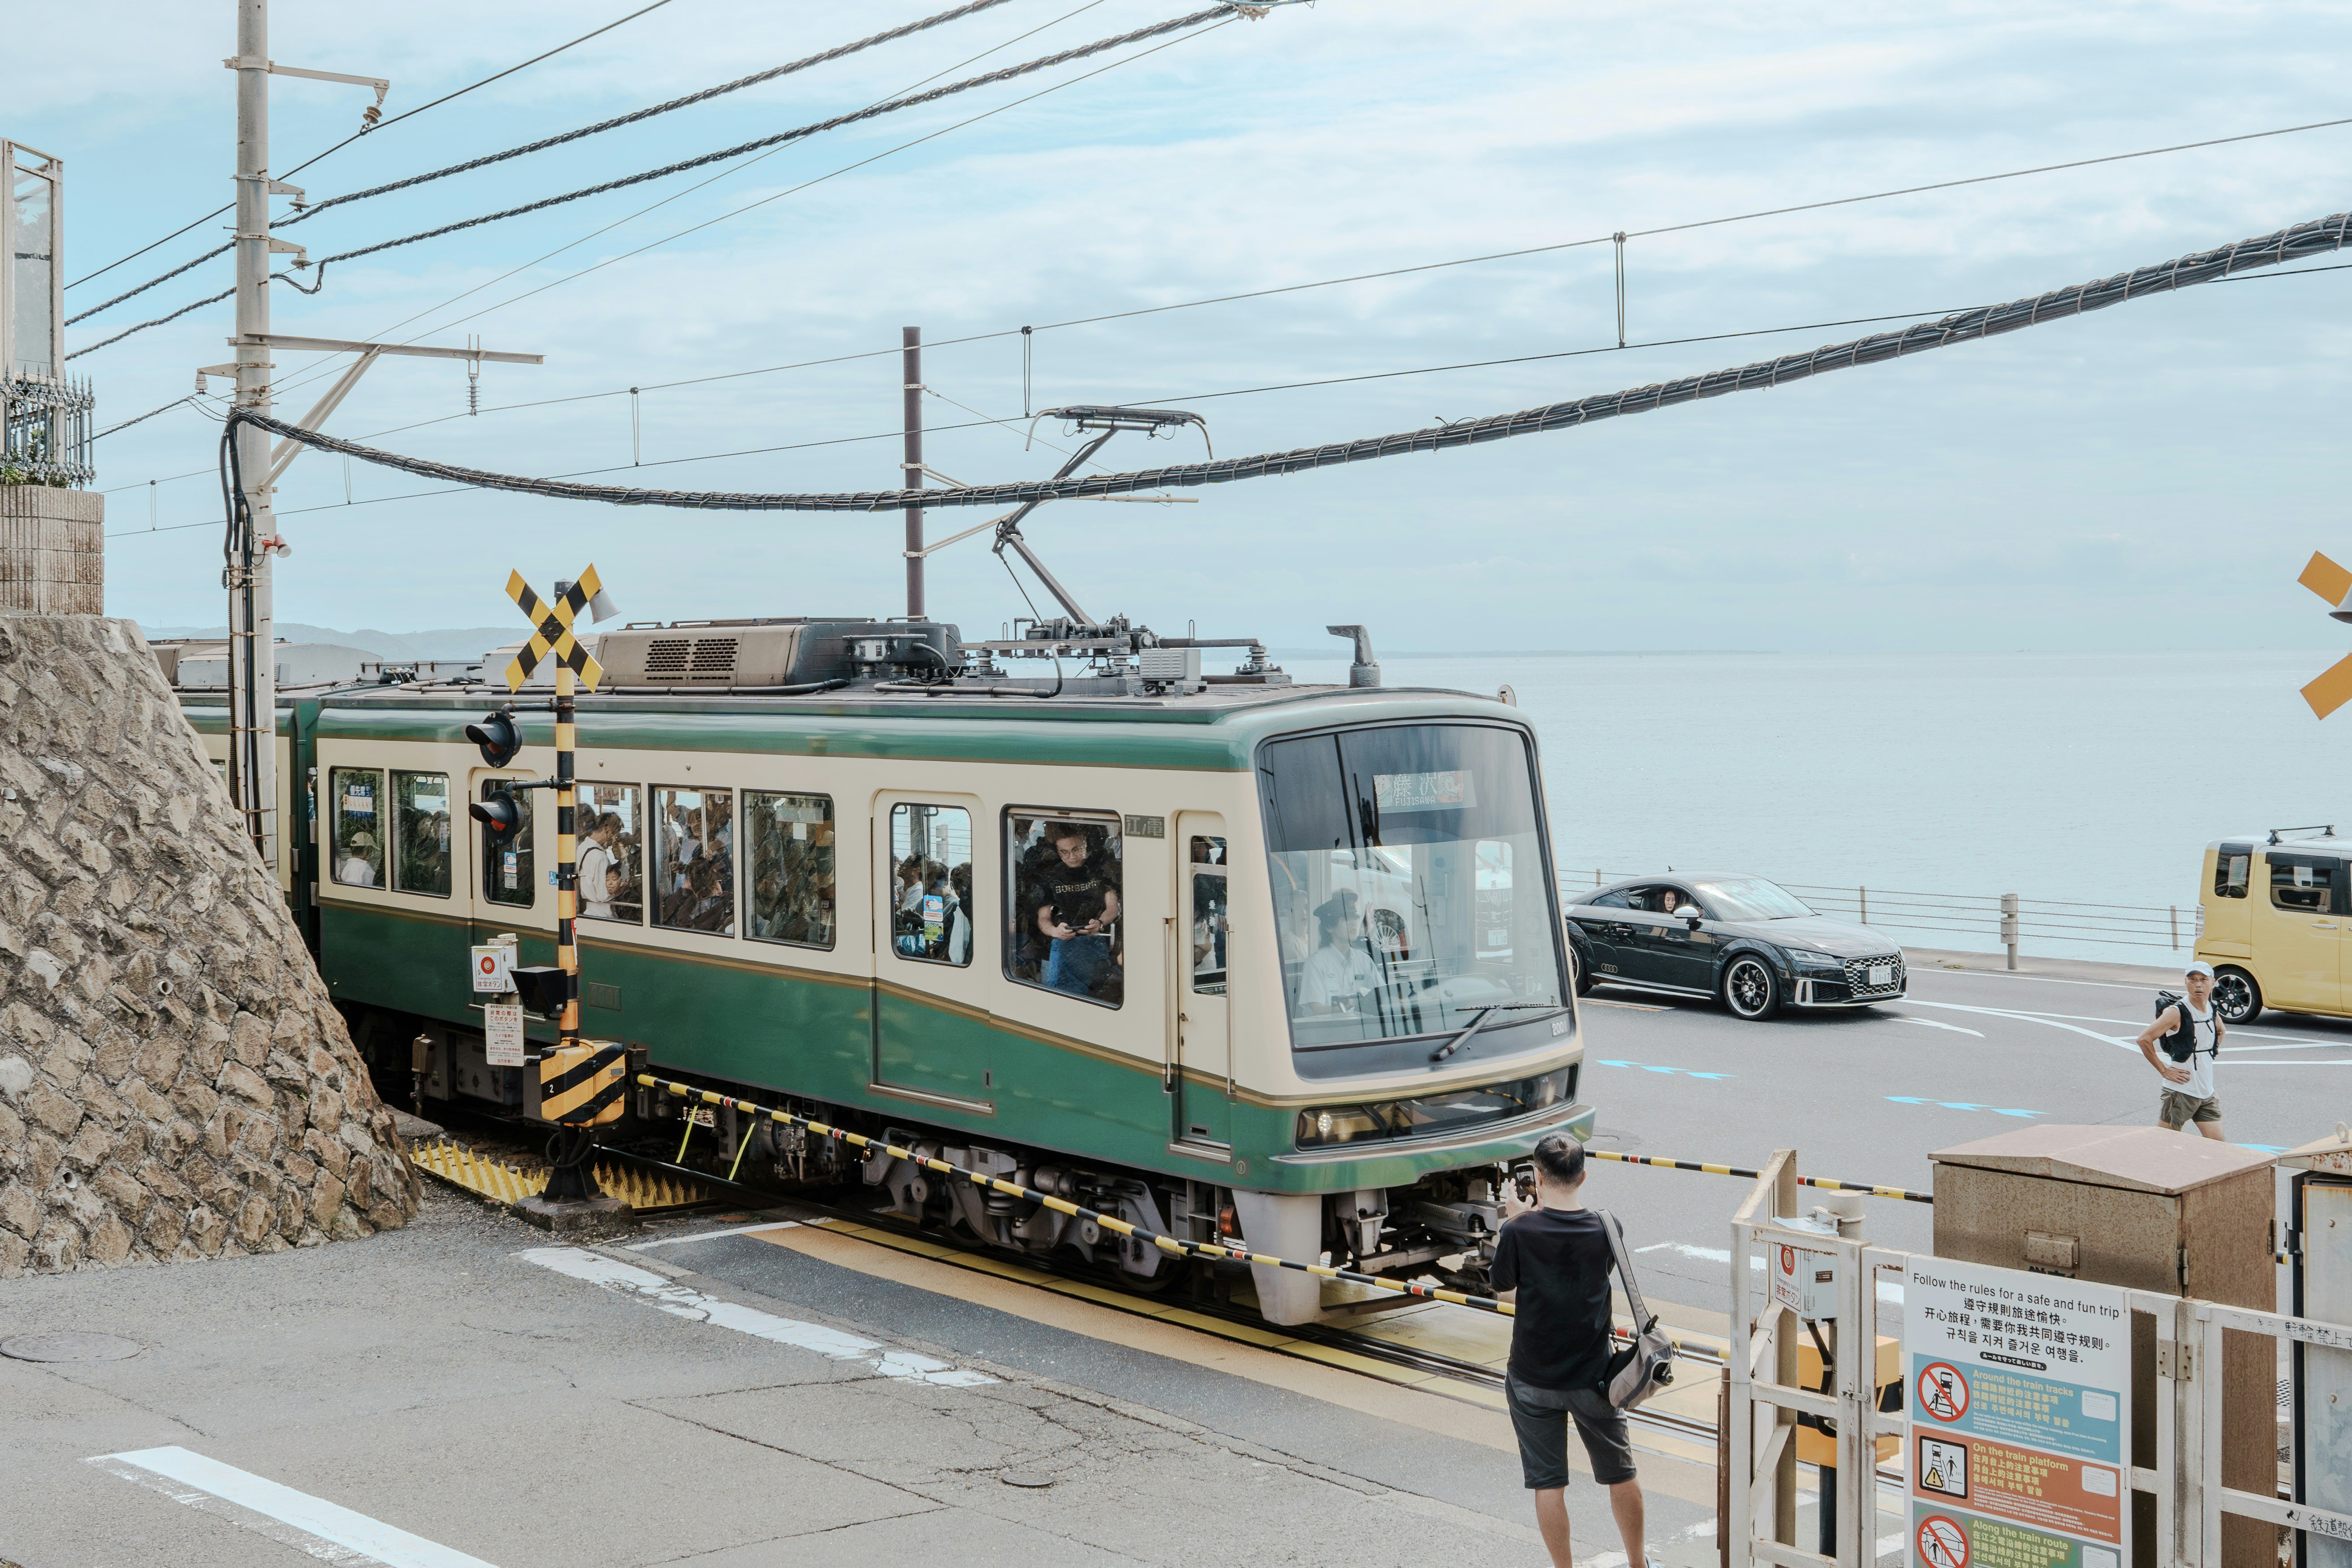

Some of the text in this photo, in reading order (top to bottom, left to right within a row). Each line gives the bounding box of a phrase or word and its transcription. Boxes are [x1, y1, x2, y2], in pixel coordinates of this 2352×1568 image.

[1393, 772, 1438, 798] 藤沢
[1395, 796, 1436, 806] FUJISAWA
[1551, 1019, 1568, 1036] 2001
[550, 1084, 554, 1093] 2
[1776, 1284, 1800, 1305] 非常ボタン
[1914, 1273, 2119, 1320] Follow the rules for a safe and fun trip
[1964, 1297, 2067, 1325] 遵守規則旅途愉快。
[1946, 1327, 2083, 1363] 규칙을 지켜 즐거운 여행을.
[1973, 1369, 2074, 1397] Around the train tracks
[1972, 1401, 1988, 1411] 선로
[1991, 1404, 2030, 1420] 주변에서의
[2034, 1412, 2050, 1424] 부탁
[2054, 1416, 2069, 1428] 말씀
[1973, 1442, 2068, 1472] On the train platform
[1973, 1473, 2042, 1497] 홈에서의 부탁 말씀
[1973, 1520, 2068, 1551] Along the train route
[1973, 1550, 2011, 1568] 연선에서의
